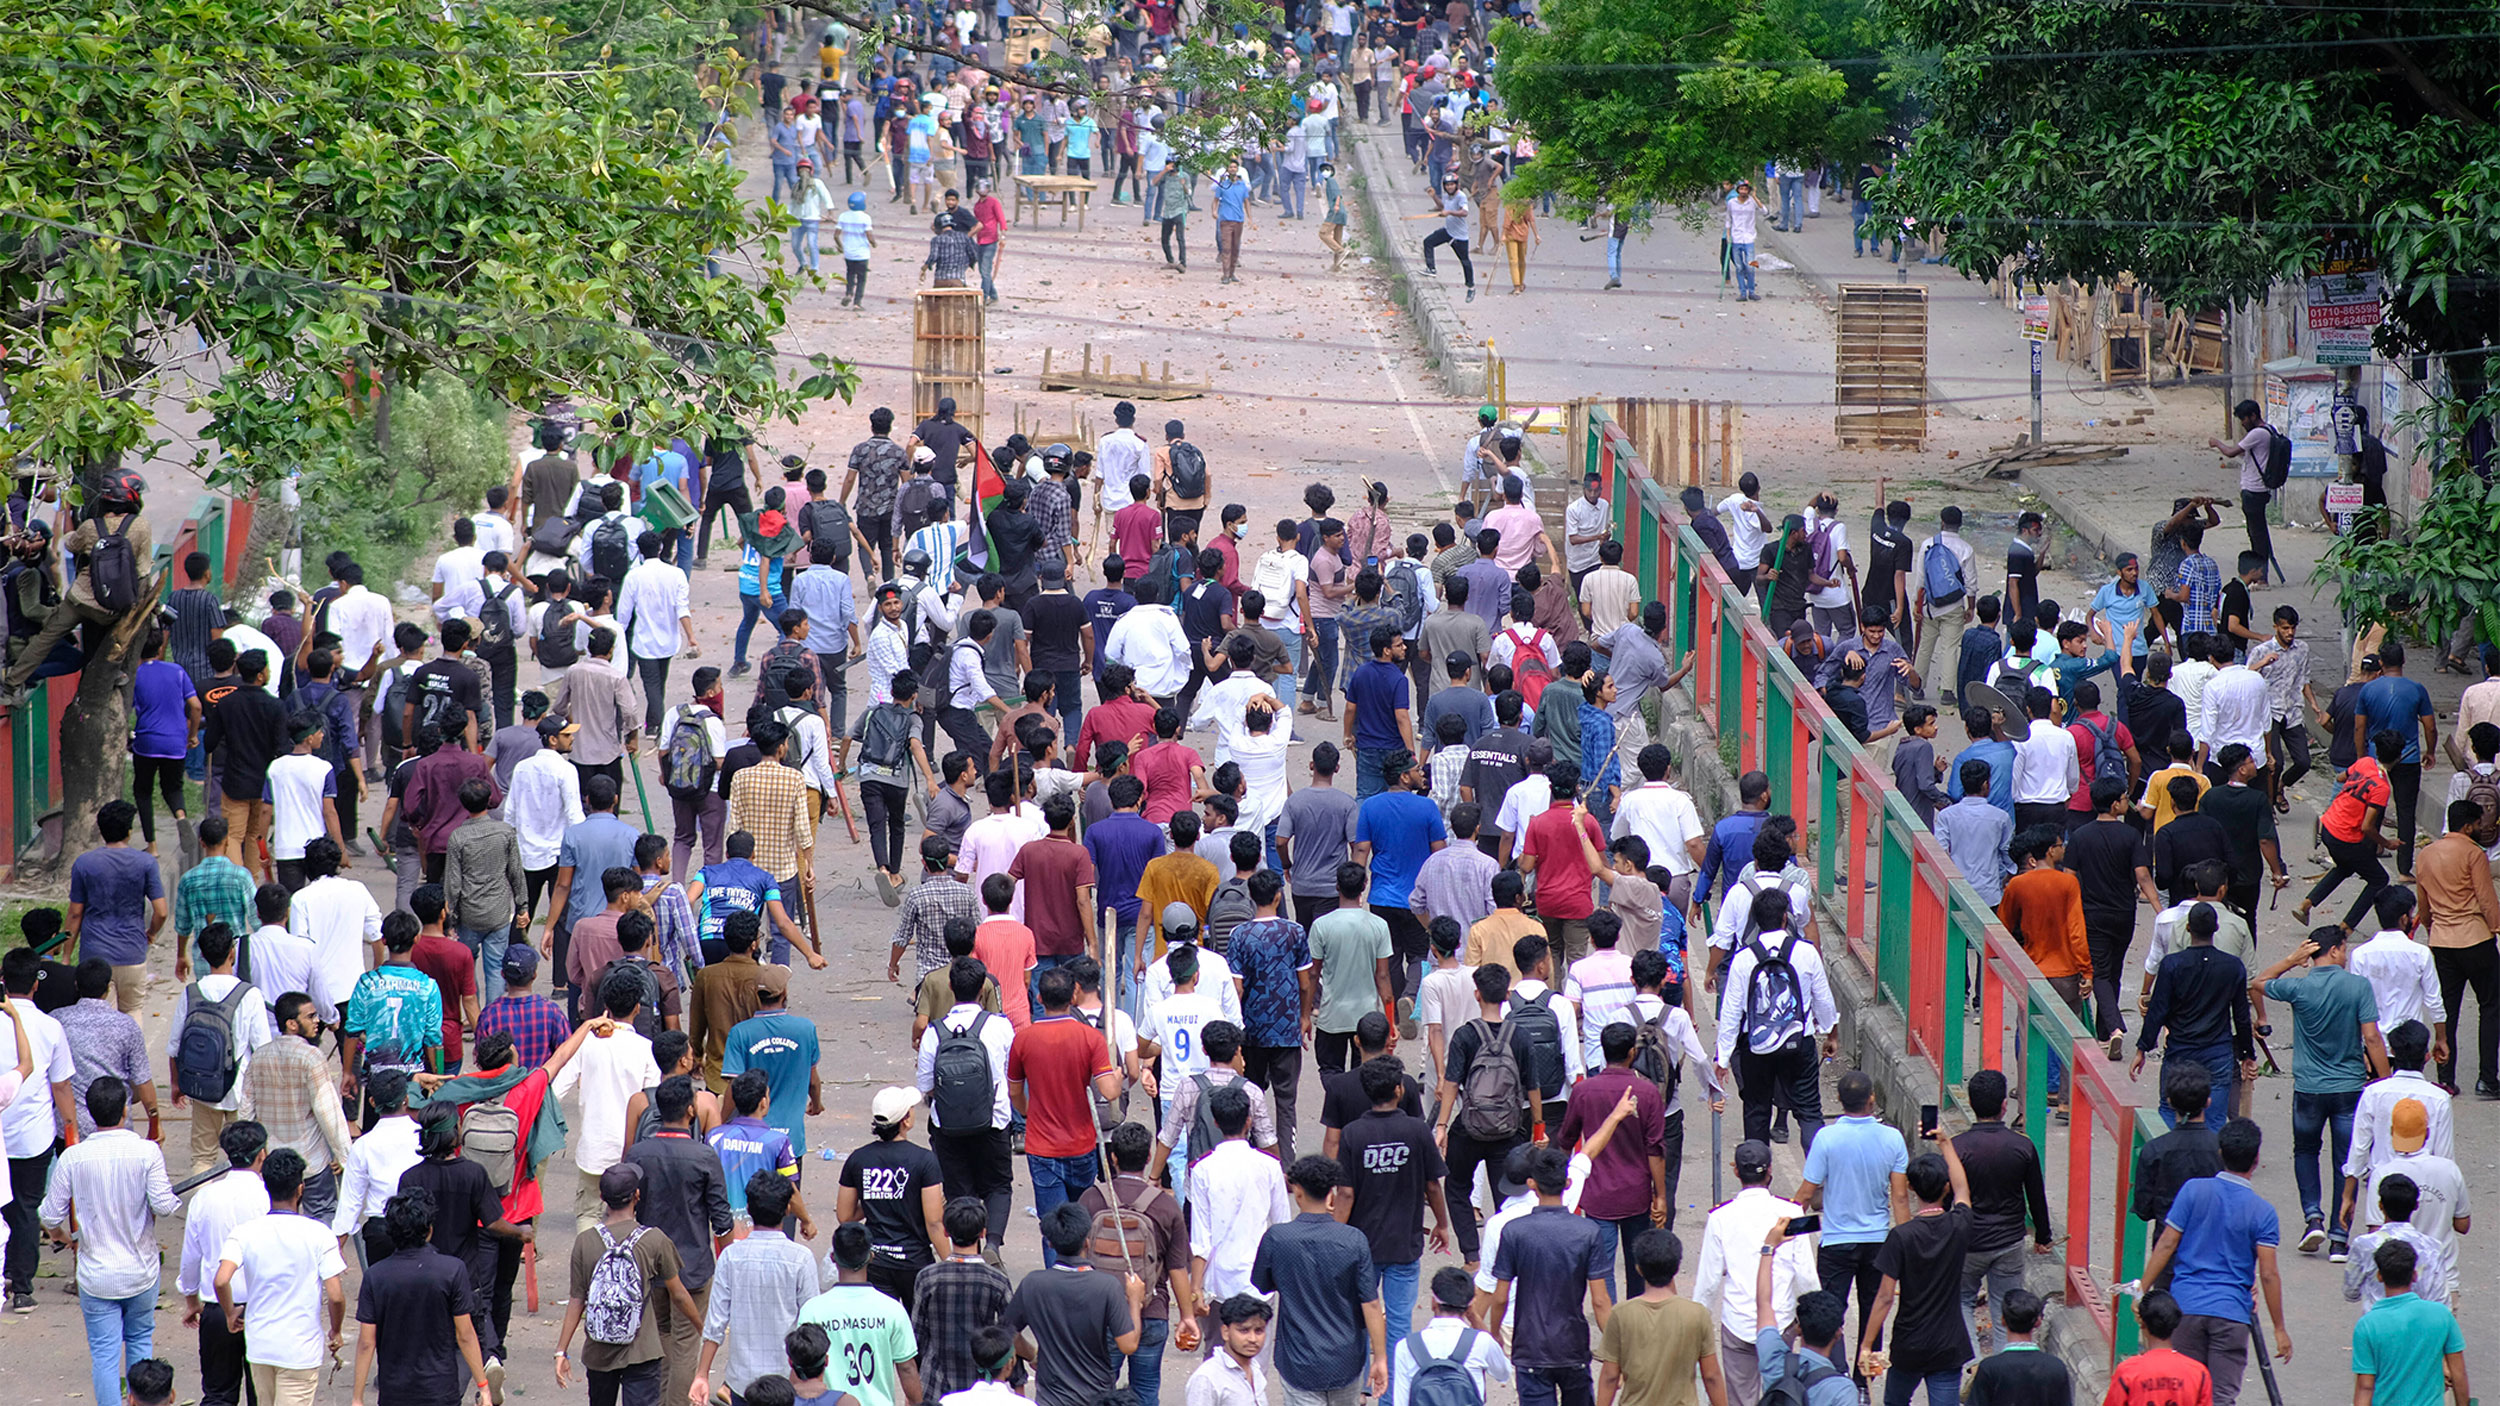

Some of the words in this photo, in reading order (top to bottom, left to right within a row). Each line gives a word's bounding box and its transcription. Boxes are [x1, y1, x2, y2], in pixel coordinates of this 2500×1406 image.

[2310, 304, 2378, 317] 01710-865598
[2311, 314, 2379, 328] 01976-624670
[1471, 750, 1518, 763] ESSENTIALS
[707, 887, 725, 899] LOVE
[386, 997, 403, 1039] 7
[1167, 1015, 1199, 1024] MAHFUZ
[749, 1038, 771, 1055] DHAKA
[771, 1037, 798, 1051] COLLEGE
[1174, 1028, 1190, 1062] 9
[723, 1138, 764, 1154] RAIYAN
[1363, 1145, 1410, 1168] DCC
[870, 1168, 893, 1191] 22
[870, 1191, 894, 1200] BATCH
[821, 1317, 885, 1331] MD.MASUM
[844, 1342, 875, 1387] 30
